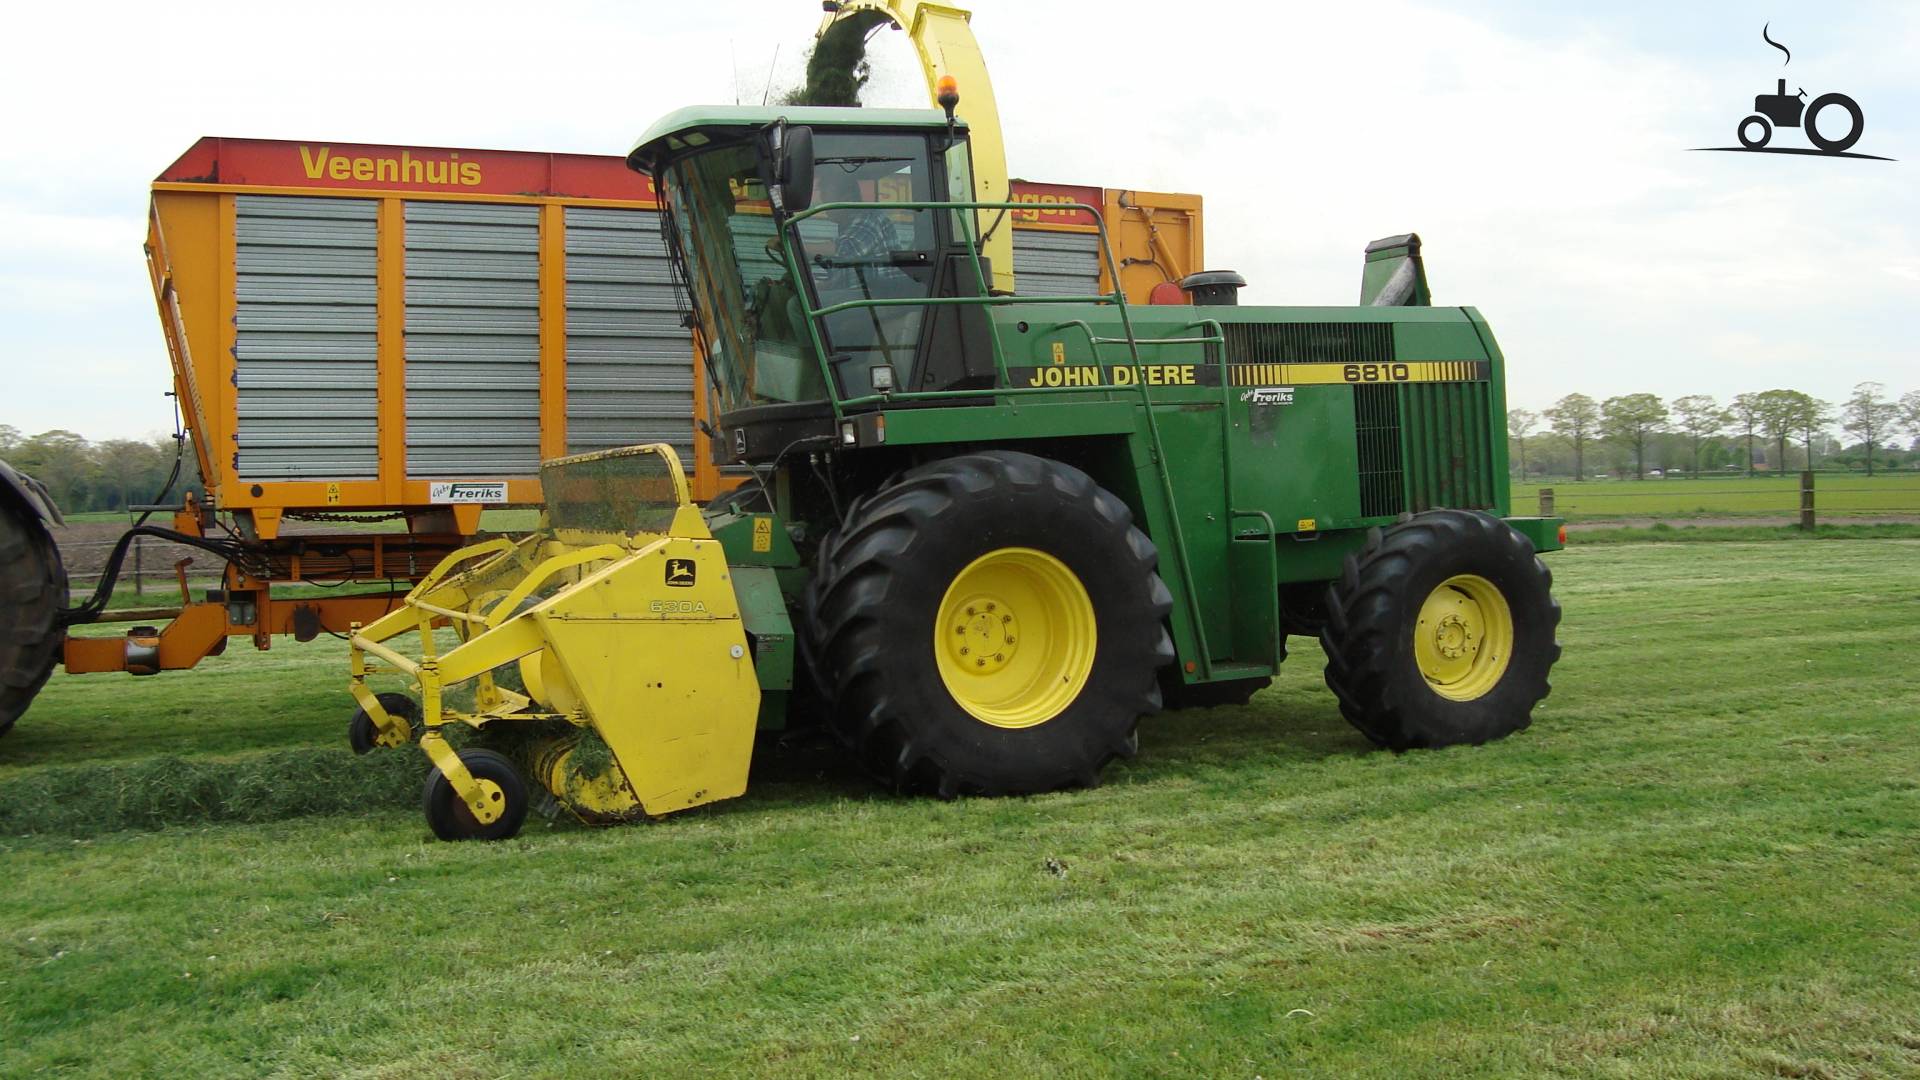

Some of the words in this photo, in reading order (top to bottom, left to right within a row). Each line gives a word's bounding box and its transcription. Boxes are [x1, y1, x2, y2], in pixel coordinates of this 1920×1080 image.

[300, 145, 482, 186] Veenhuis
[1030, 366, 1099, 387] JOHN
[1343, 364, 1409, 381] 6810
[1252, 387, 1295, 402] Freriks
[449, 483, 504, 498] Freriks
[650, 600, 708, 613] 630A
